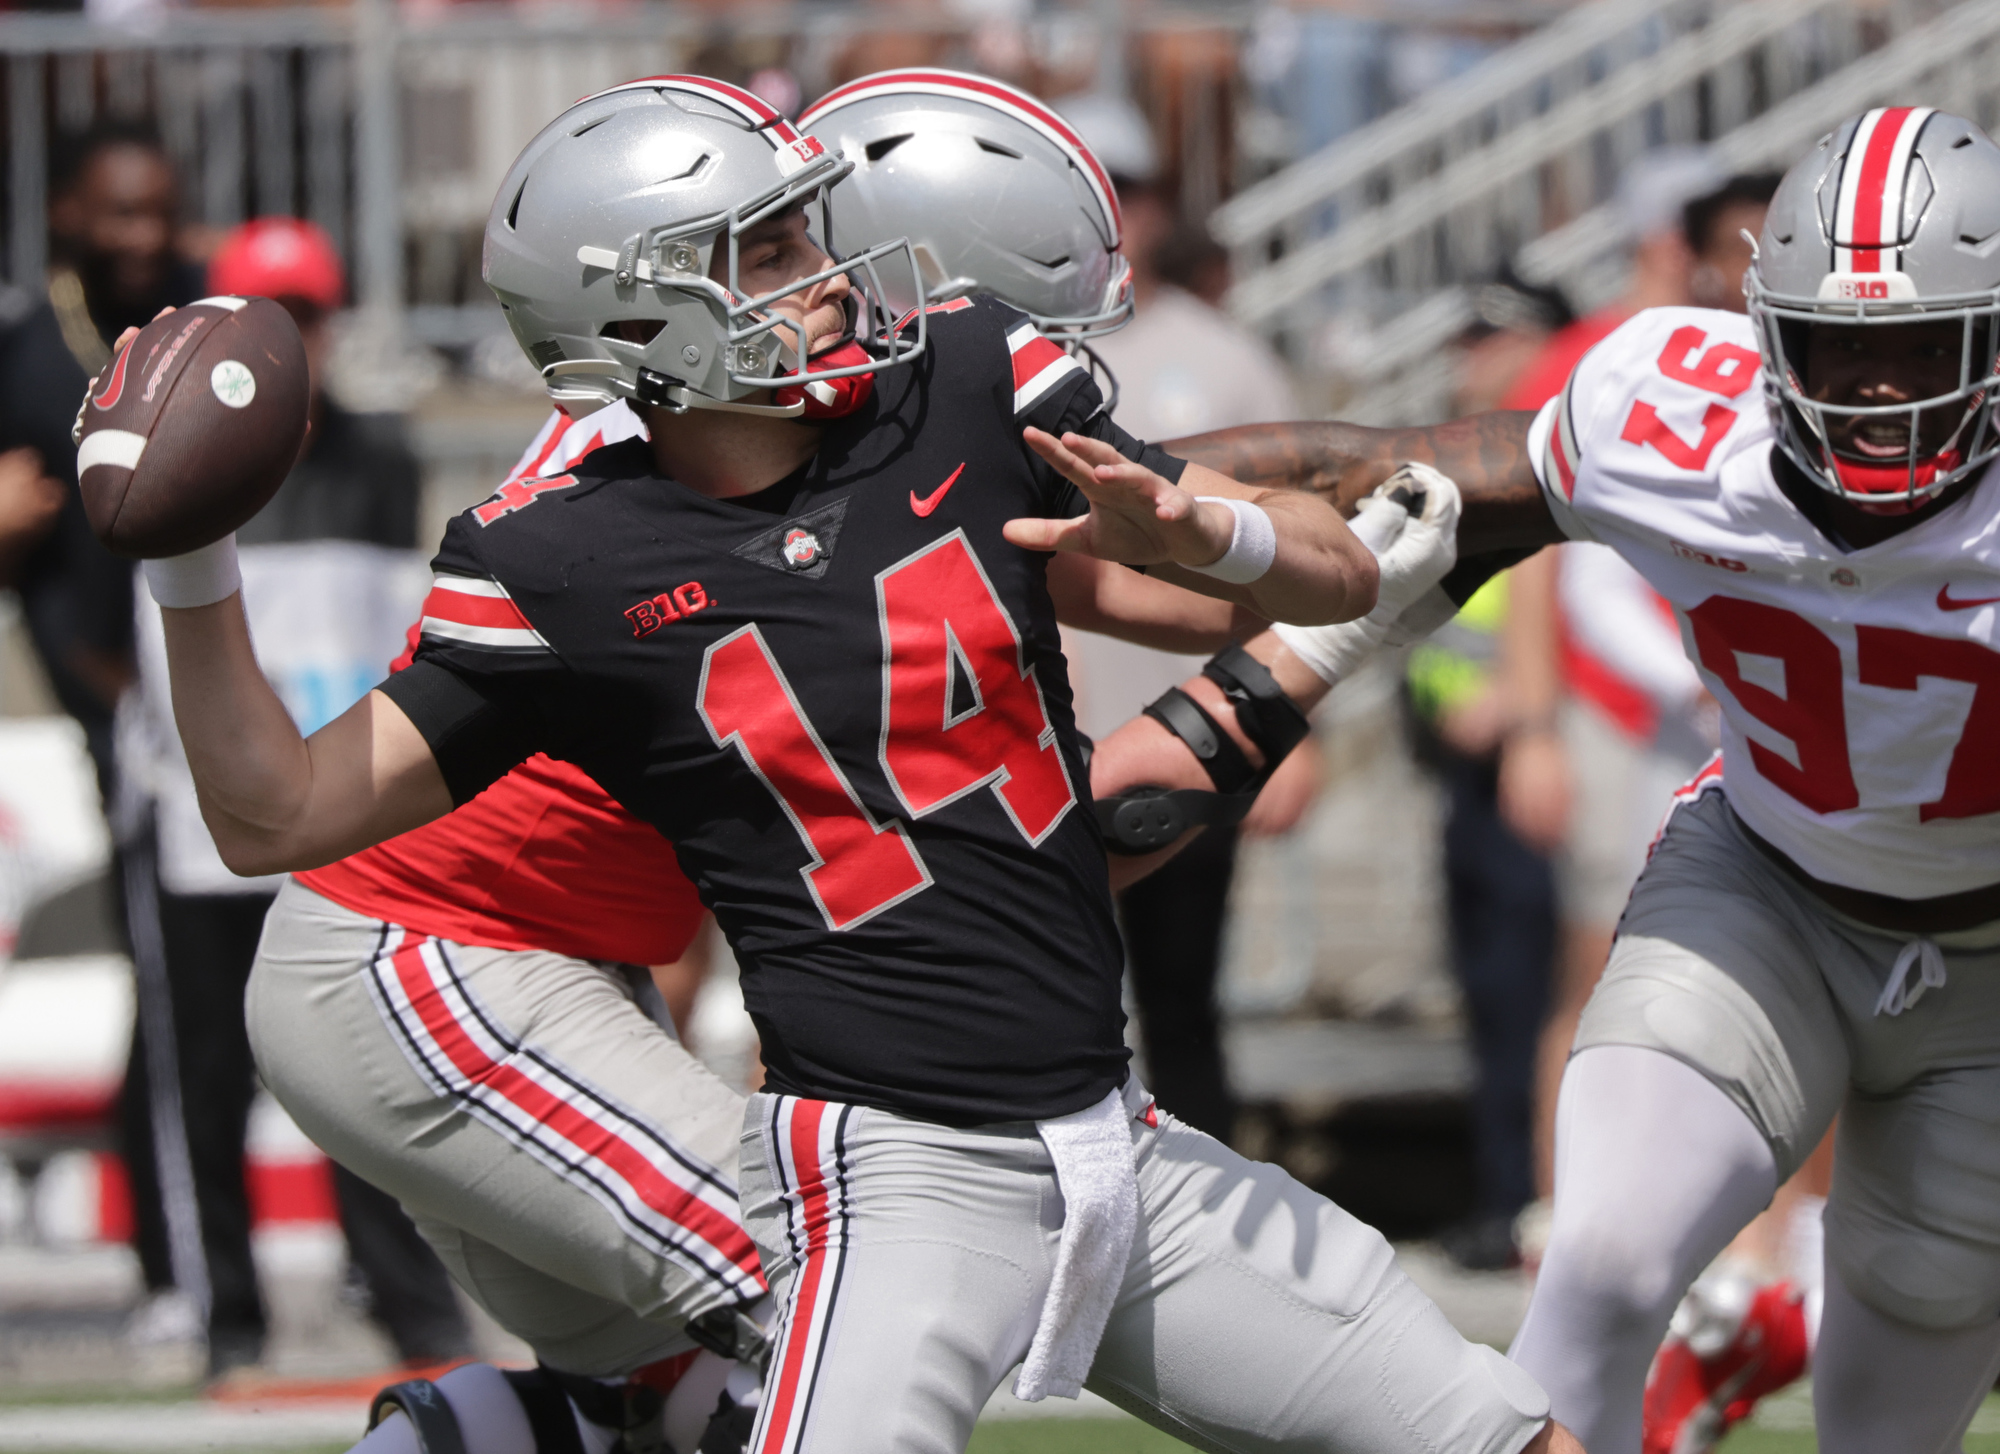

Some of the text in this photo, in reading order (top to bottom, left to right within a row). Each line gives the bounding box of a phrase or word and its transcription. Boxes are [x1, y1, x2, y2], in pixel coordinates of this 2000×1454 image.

[1620, 325, 1764, 472] 97
[696, 527, 1078, 932] 14
[1685, 594, 2000, 824] 97
